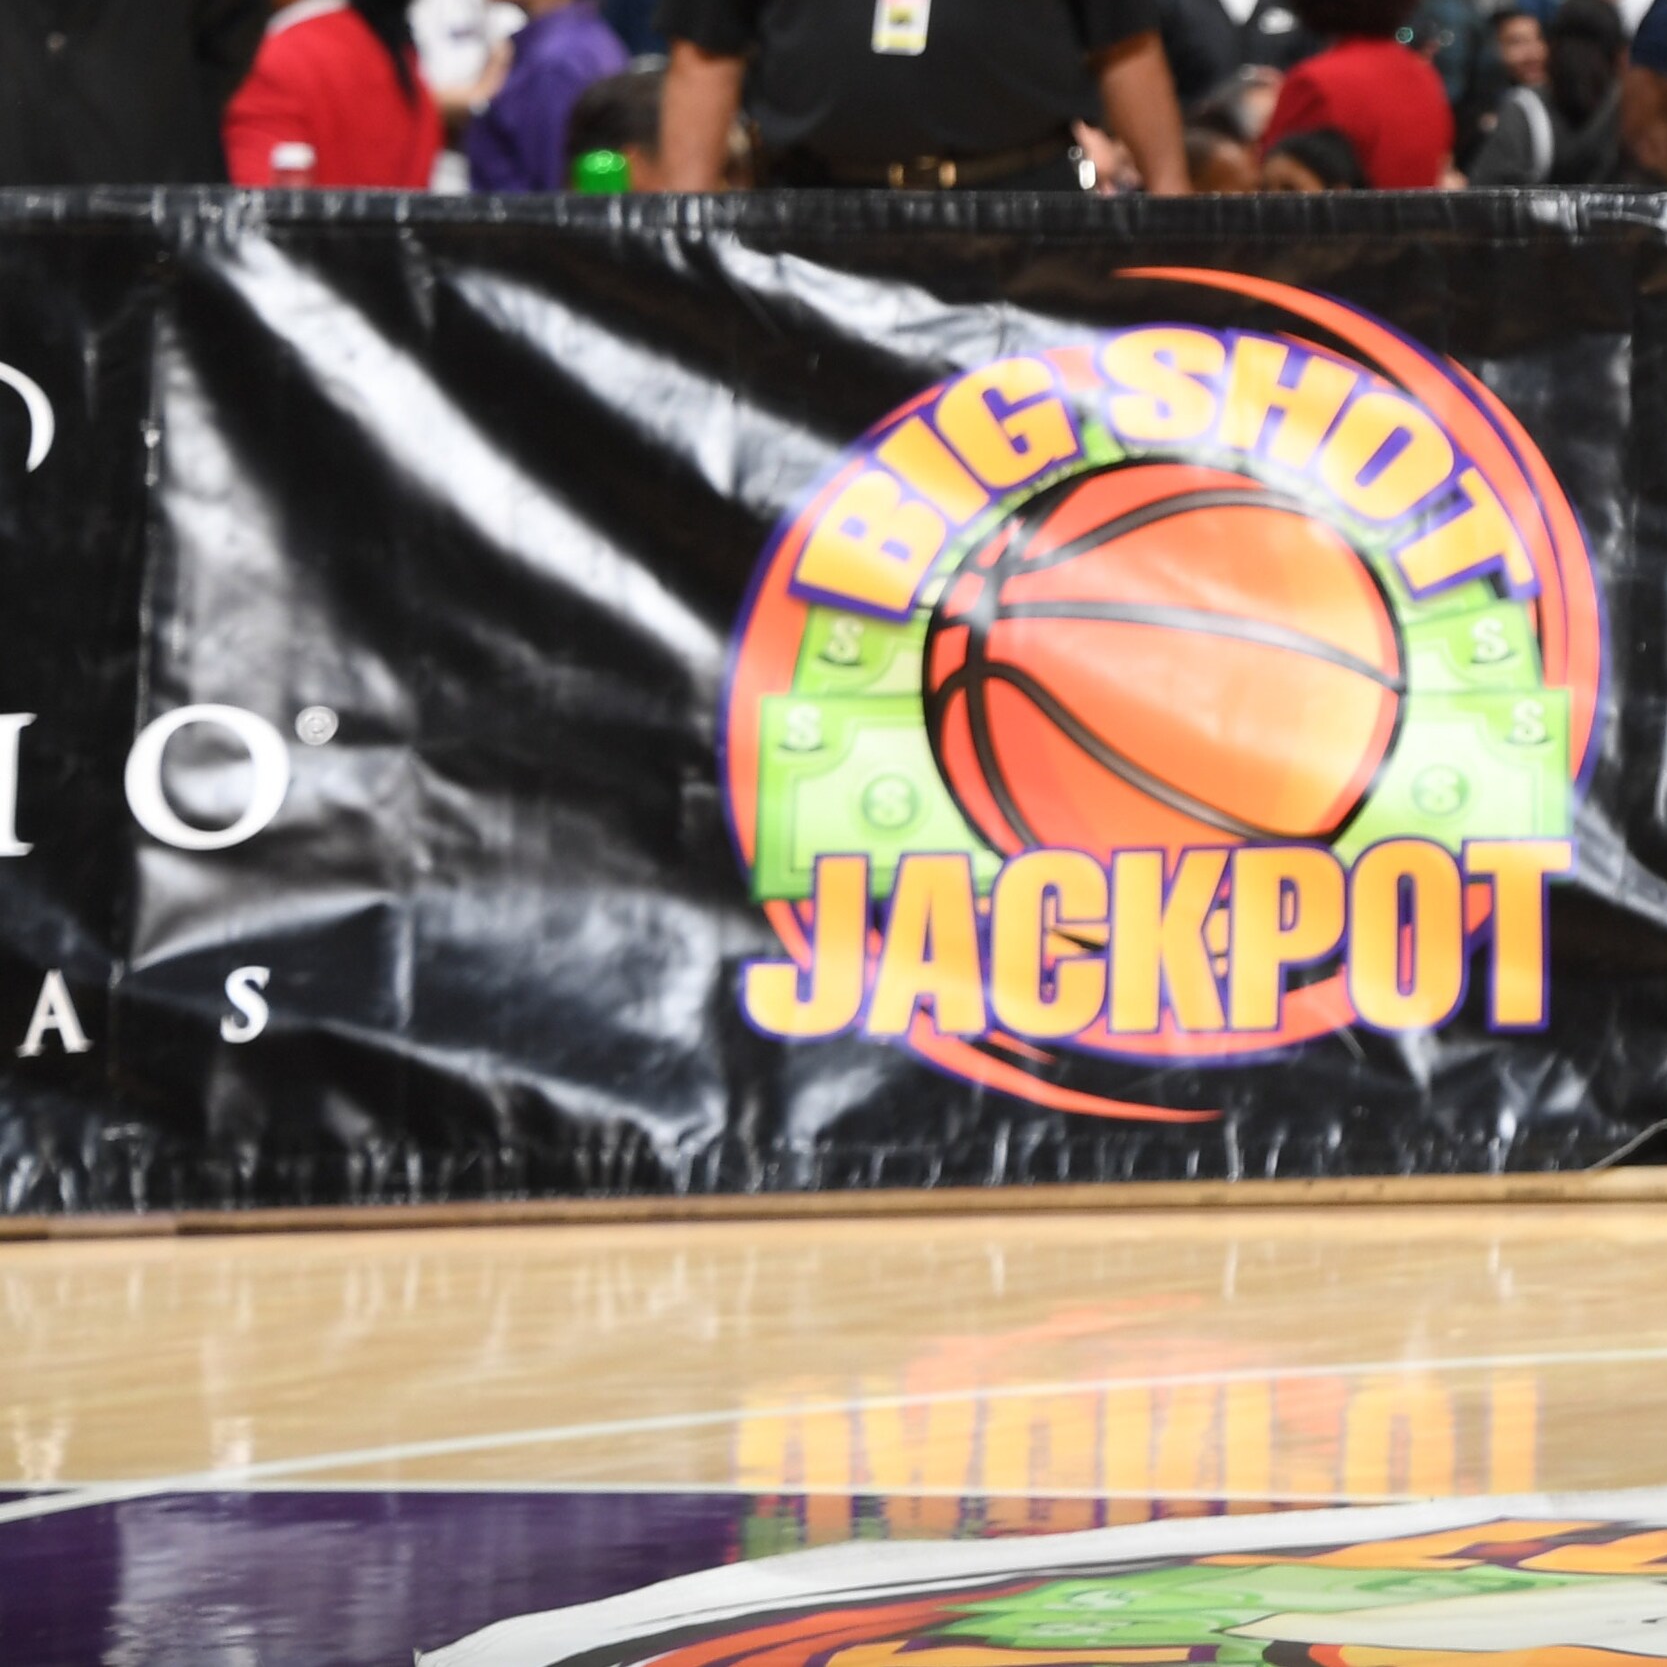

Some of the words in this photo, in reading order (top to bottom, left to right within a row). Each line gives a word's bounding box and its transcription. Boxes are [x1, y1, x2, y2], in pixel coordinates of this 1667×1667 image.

[788, 352, 1086, 622] BIG
[1097, 323, 1540, 600] SHOT
[740, 837, 1578, 1040] JACKPOT
